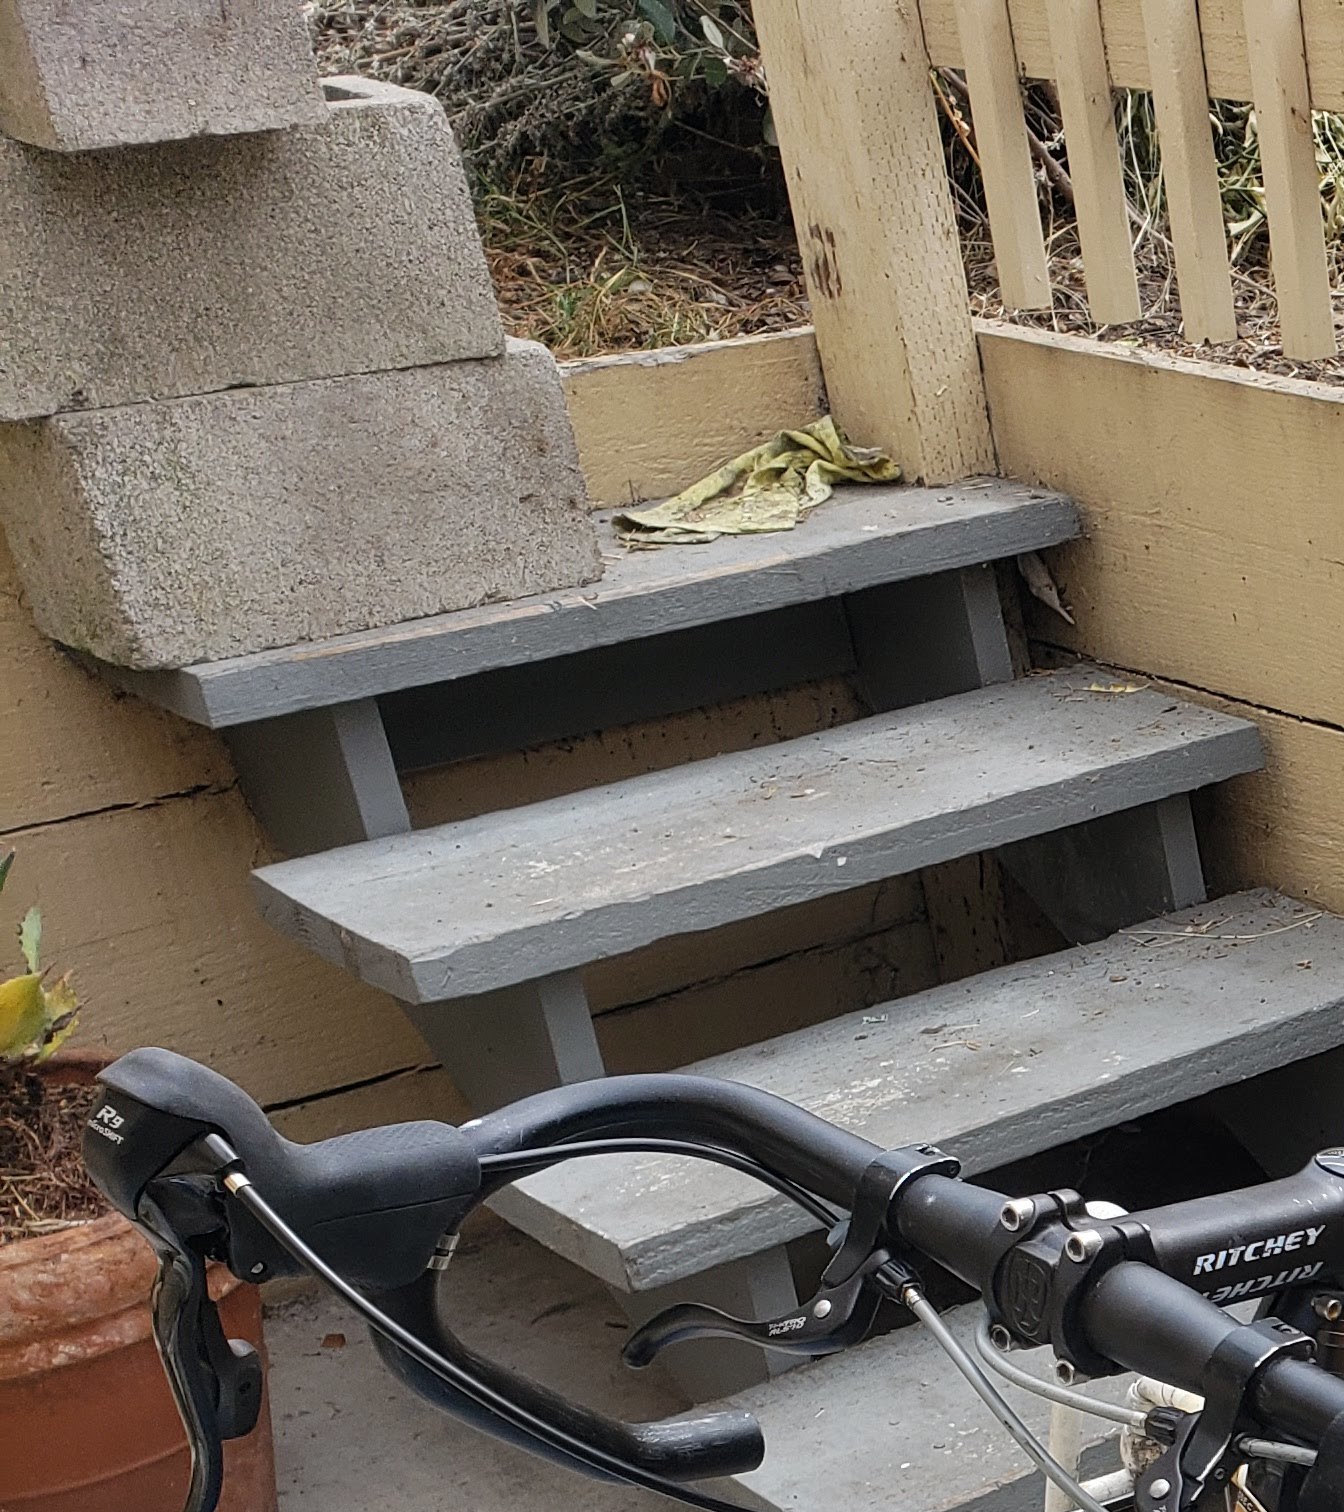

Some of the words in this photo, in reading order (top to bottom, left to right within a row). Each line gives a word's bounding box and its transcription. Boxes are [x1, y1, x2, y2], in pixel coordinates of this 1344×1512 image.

[96, 1105, 124, 1129] R9
[1192, 1224, 1326, 1276] RITCHEY
[1201, 1261, 1324, 1303] RITCHE
